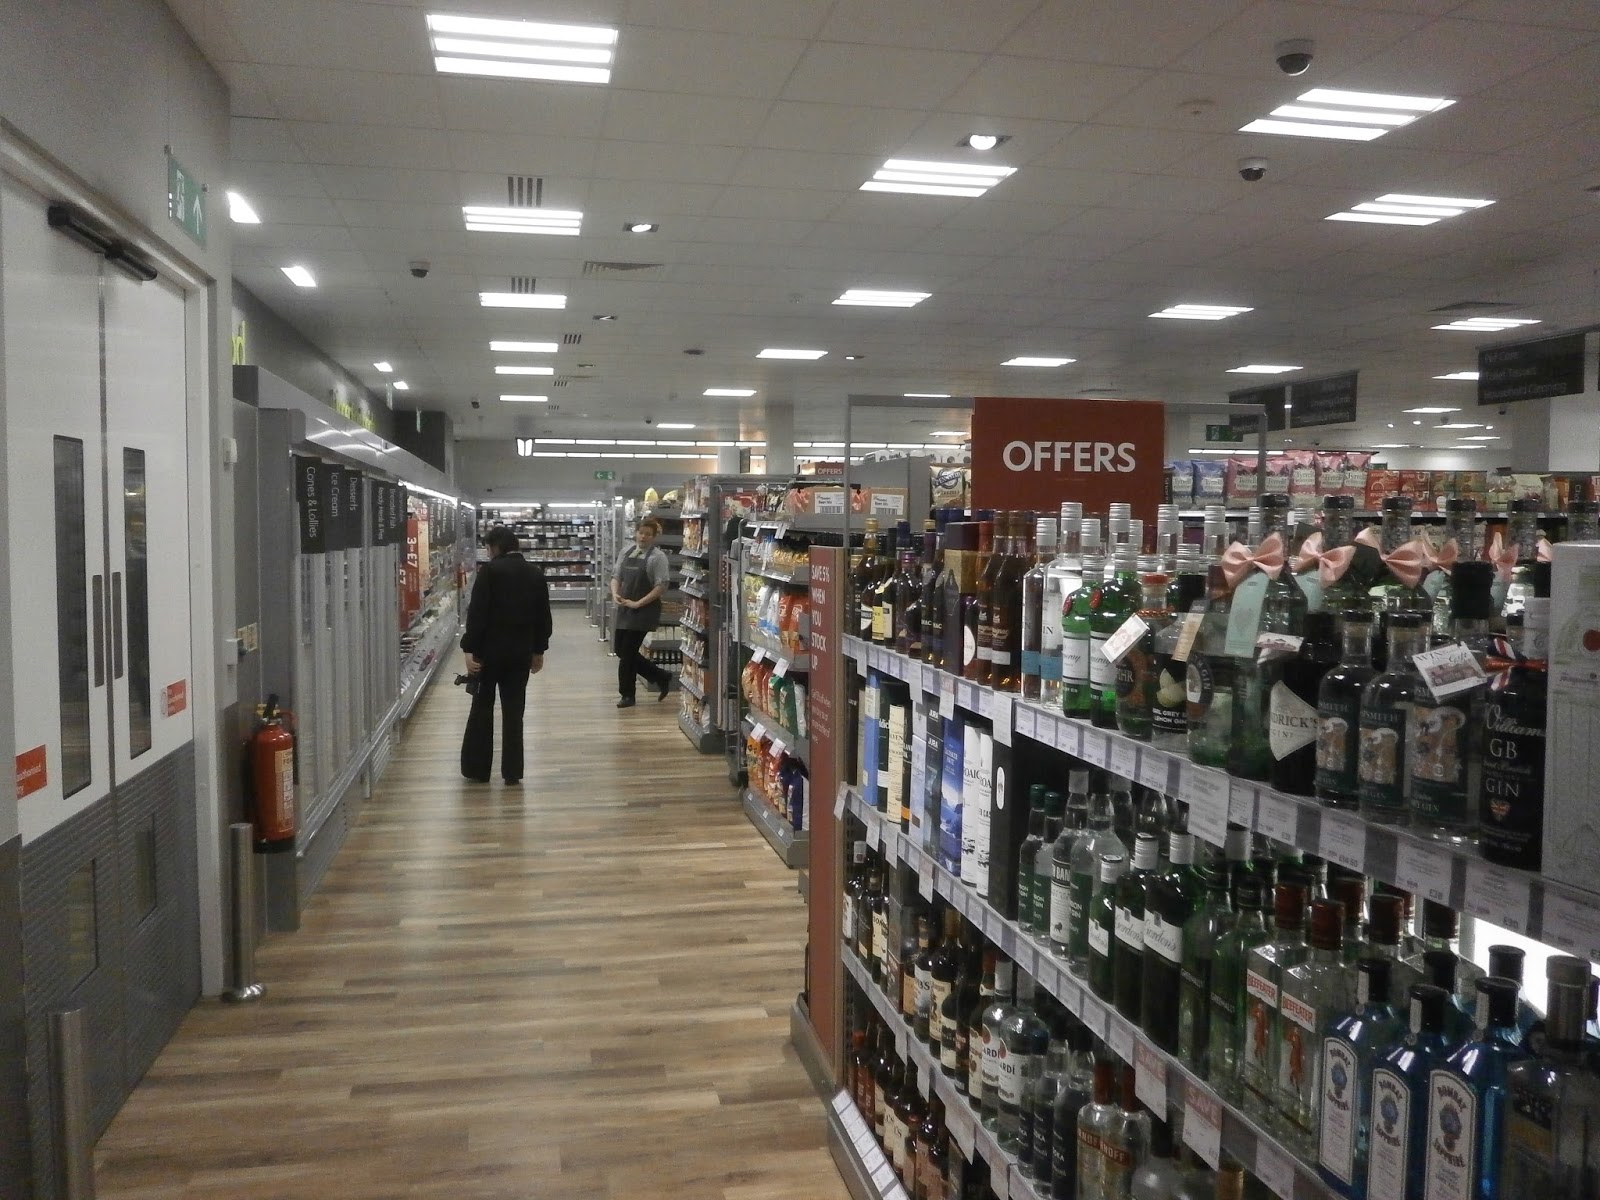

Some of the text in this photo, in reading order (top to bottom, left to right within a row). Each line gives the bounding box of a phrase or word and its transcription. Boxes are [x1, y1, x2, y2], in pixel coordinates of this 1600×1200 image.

[1003, 440, 1136, 473] OFFERS
[306, 466, 319, 538] Cones & Lollies
[331, 472, 340, 518] Ice Cream
[349, 477, 359, 511] Desserts
[406, 536, 417, 545] 3
[407, 553, 418, 568] £7
[811, 587, 826, 605] WHEN
[811, 609, 822, 627] YOU
[811, 631, 827, 652] STOCK
[811, 653, 818, 671] UP
[1162, 709, 1181, 717] GREY
[1489, 738, 1518, 759] GB
[1485, 778, 1520, 797] GIN
[1282, 995, 1313, 1026] BEEFEATER
